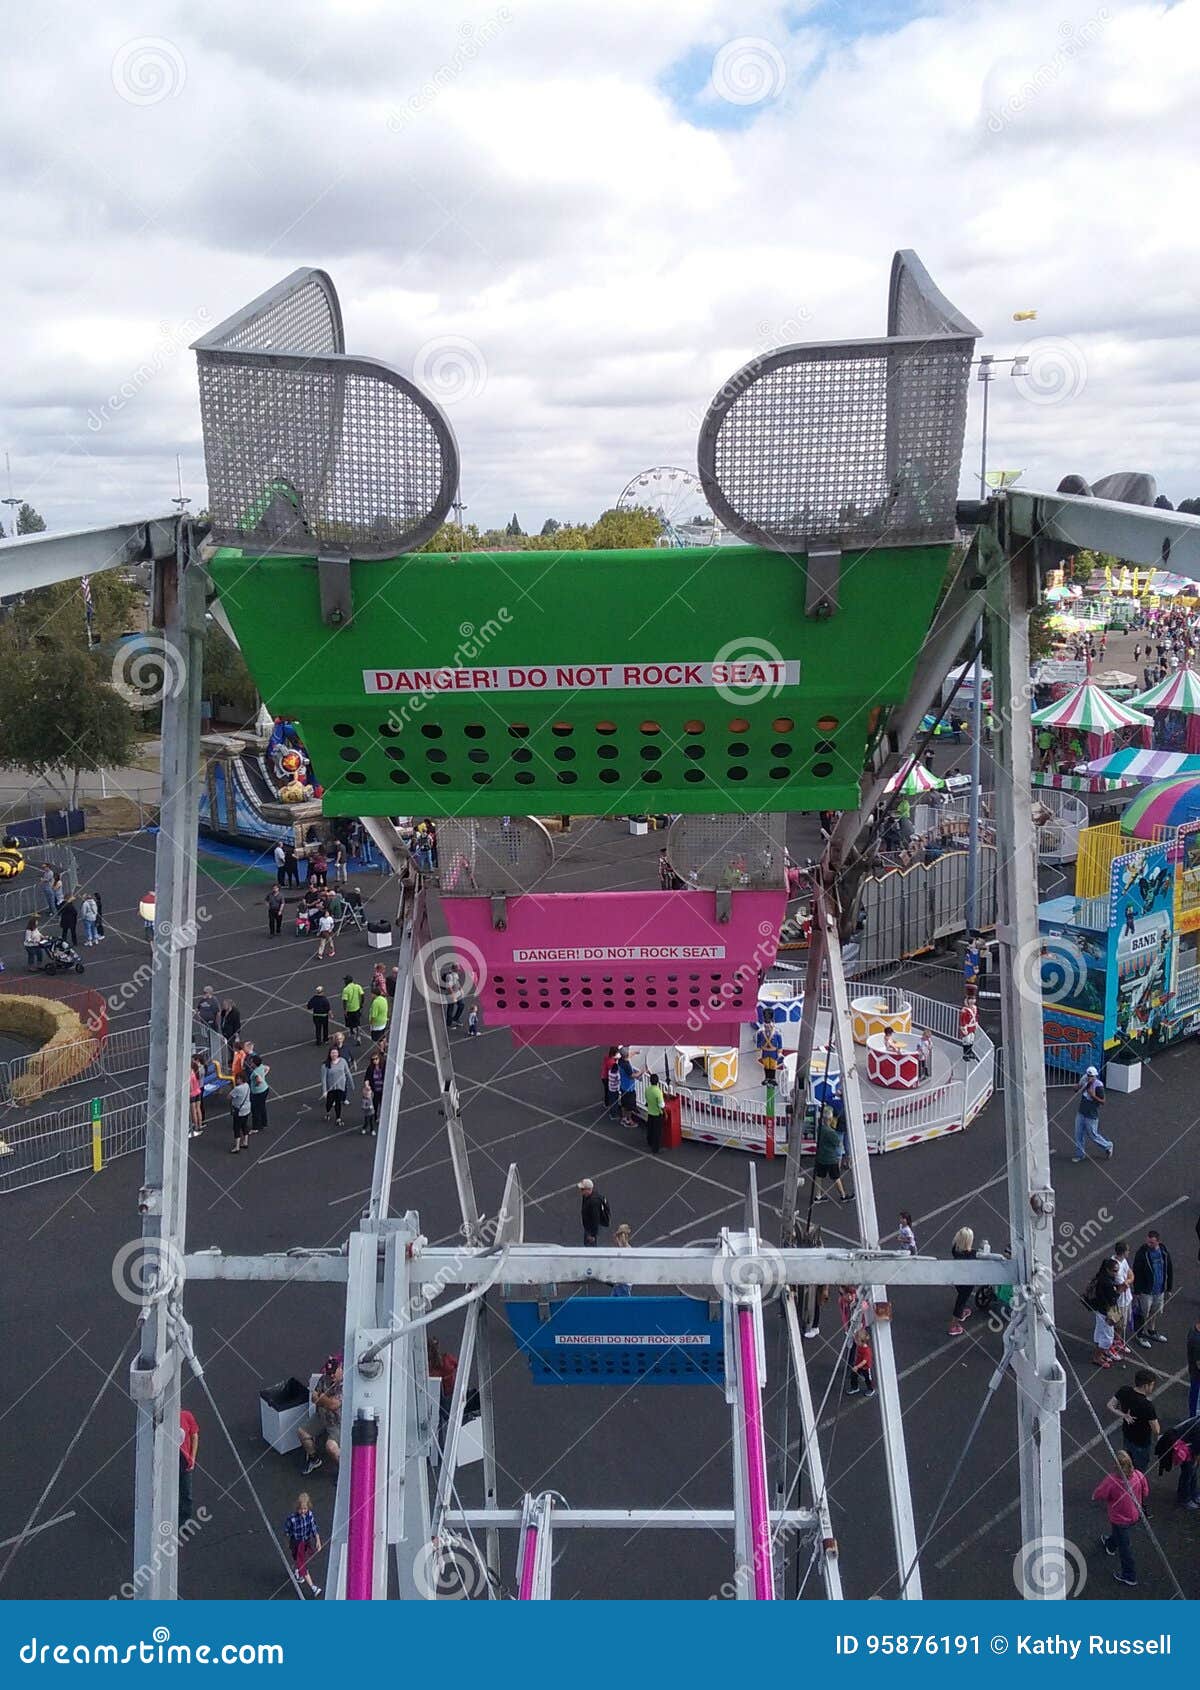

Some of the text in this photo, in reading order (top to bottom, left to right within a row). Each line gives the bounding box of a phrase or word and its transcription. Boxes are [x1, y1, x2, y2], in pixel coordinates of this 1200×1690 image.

[375, 663, 785, 691] DANGER! DO NOT ROCK SEAT
[1131, 931, 1157, 952] BANK
[519, 947, 718, 961] DANGER! DO NOT ROCK SEAT
[559, 1335, 705, 1344] DANGER! DO NOT ROCK SEAT
